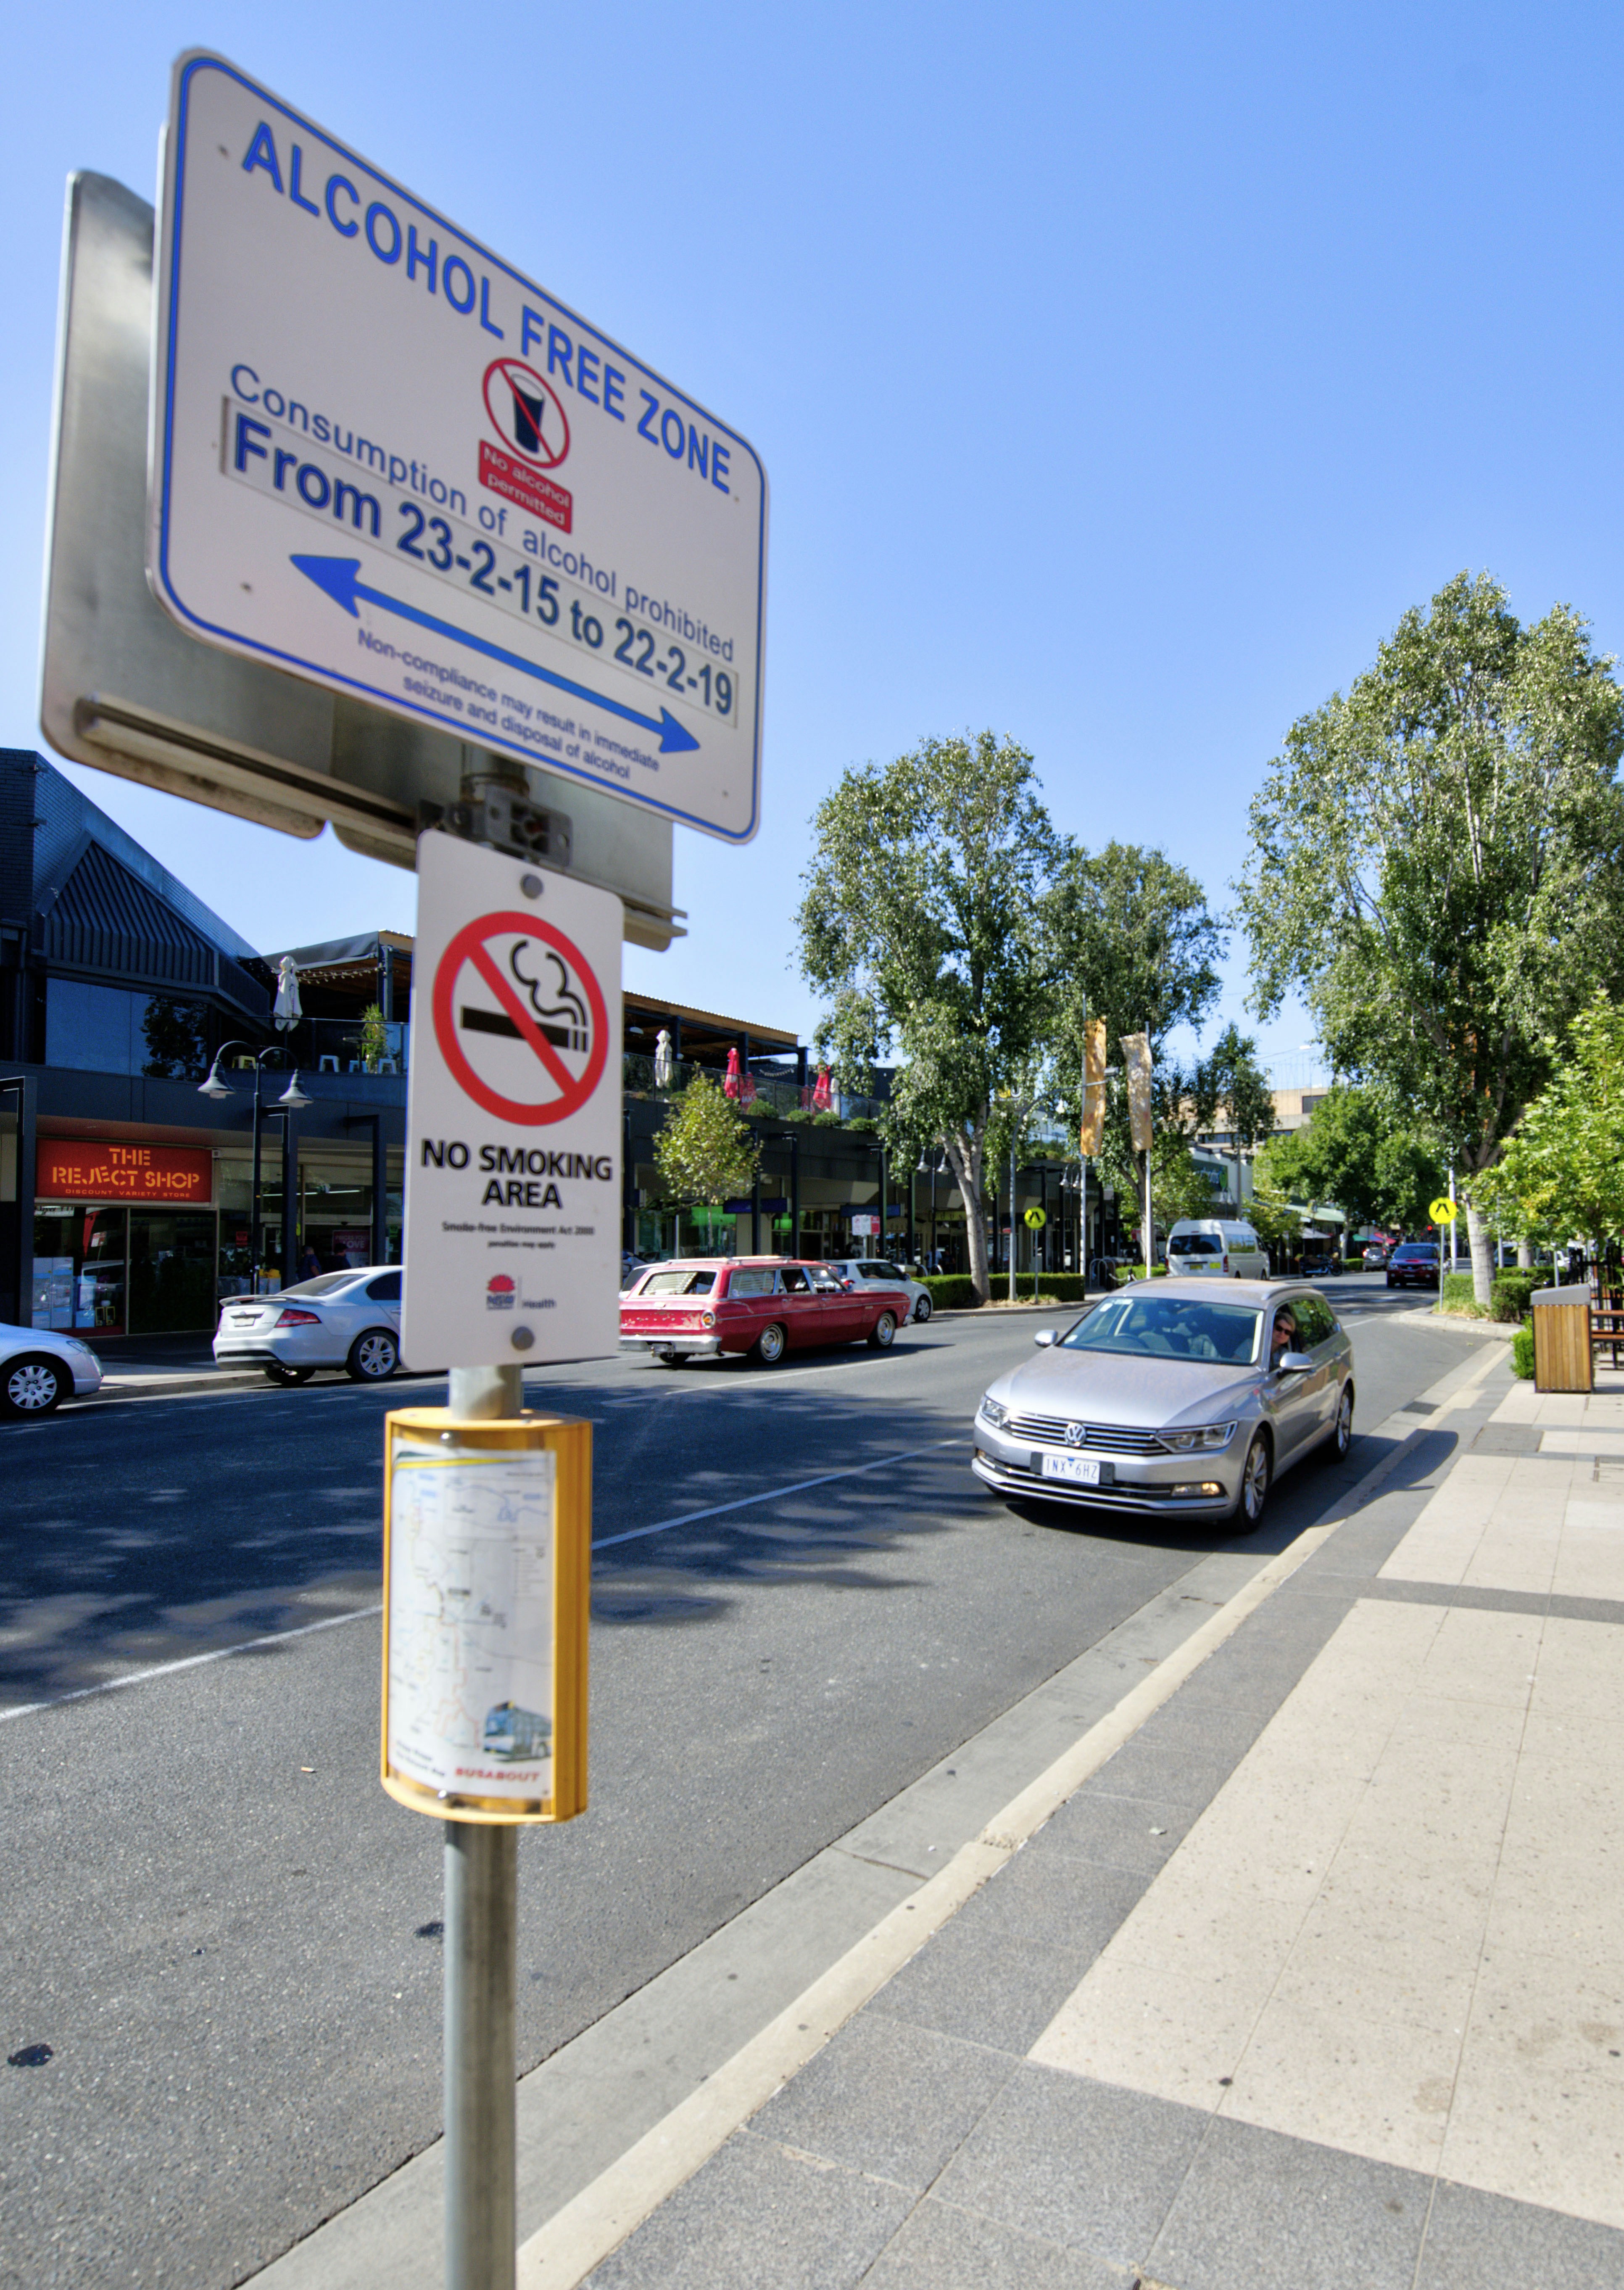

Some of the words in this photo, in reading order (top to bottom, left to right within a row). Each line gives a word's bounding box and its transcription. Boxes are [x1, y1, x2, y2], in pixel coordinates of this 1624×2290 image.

[242, 120, 504, 339] ALCOHOL
[521, 304, 625, 422] FREE
[637, 388, 731, 494] ZONE
[484, 446, 509, 472] No
[511, 466, 569, 508] alcohol
[487, 472, 565, 526] permitted
[231, 363, 467, 517] Consumption
[478, 505, 508, 537] of
[522, 528, 617, 597] alcohol
[625, 586, 734, 662] prohibited
[235, 412, 381, 538] From
[397, 501, 560, 626] 23-2-15
[570, 600, 604, 649] to
[614, 617, 732, 715] 22-2-19
[358, 628, 499, 702] Non-compliance
[501, 692, 534, 720] may
[536, 708, 576, 736] result
[579, 724, 591, 742] in
[594, 729, 659, 772] immediate
[403, 676, 464, 711] seizure
[467, 701, 498, 726] and
[501, 712, 562, 751] disposal
[565, 739, 580, 758] of
[583, 748, 630, 779] alcohol
[52, 1166, 138, 1187] REJECT
[145, 1171, 200, 1189] SHOP
[109, 1148, 151, 1166] THE
[422, 1139, 471, 1169] NO
[479, 1144, 612, 1181] SMOKING
[482, 1179, 563, 1209] AREA
[1075, 1462, 1098, 1479] 6HZ
[455, 1766, 540, 1782] BUSABOUT
